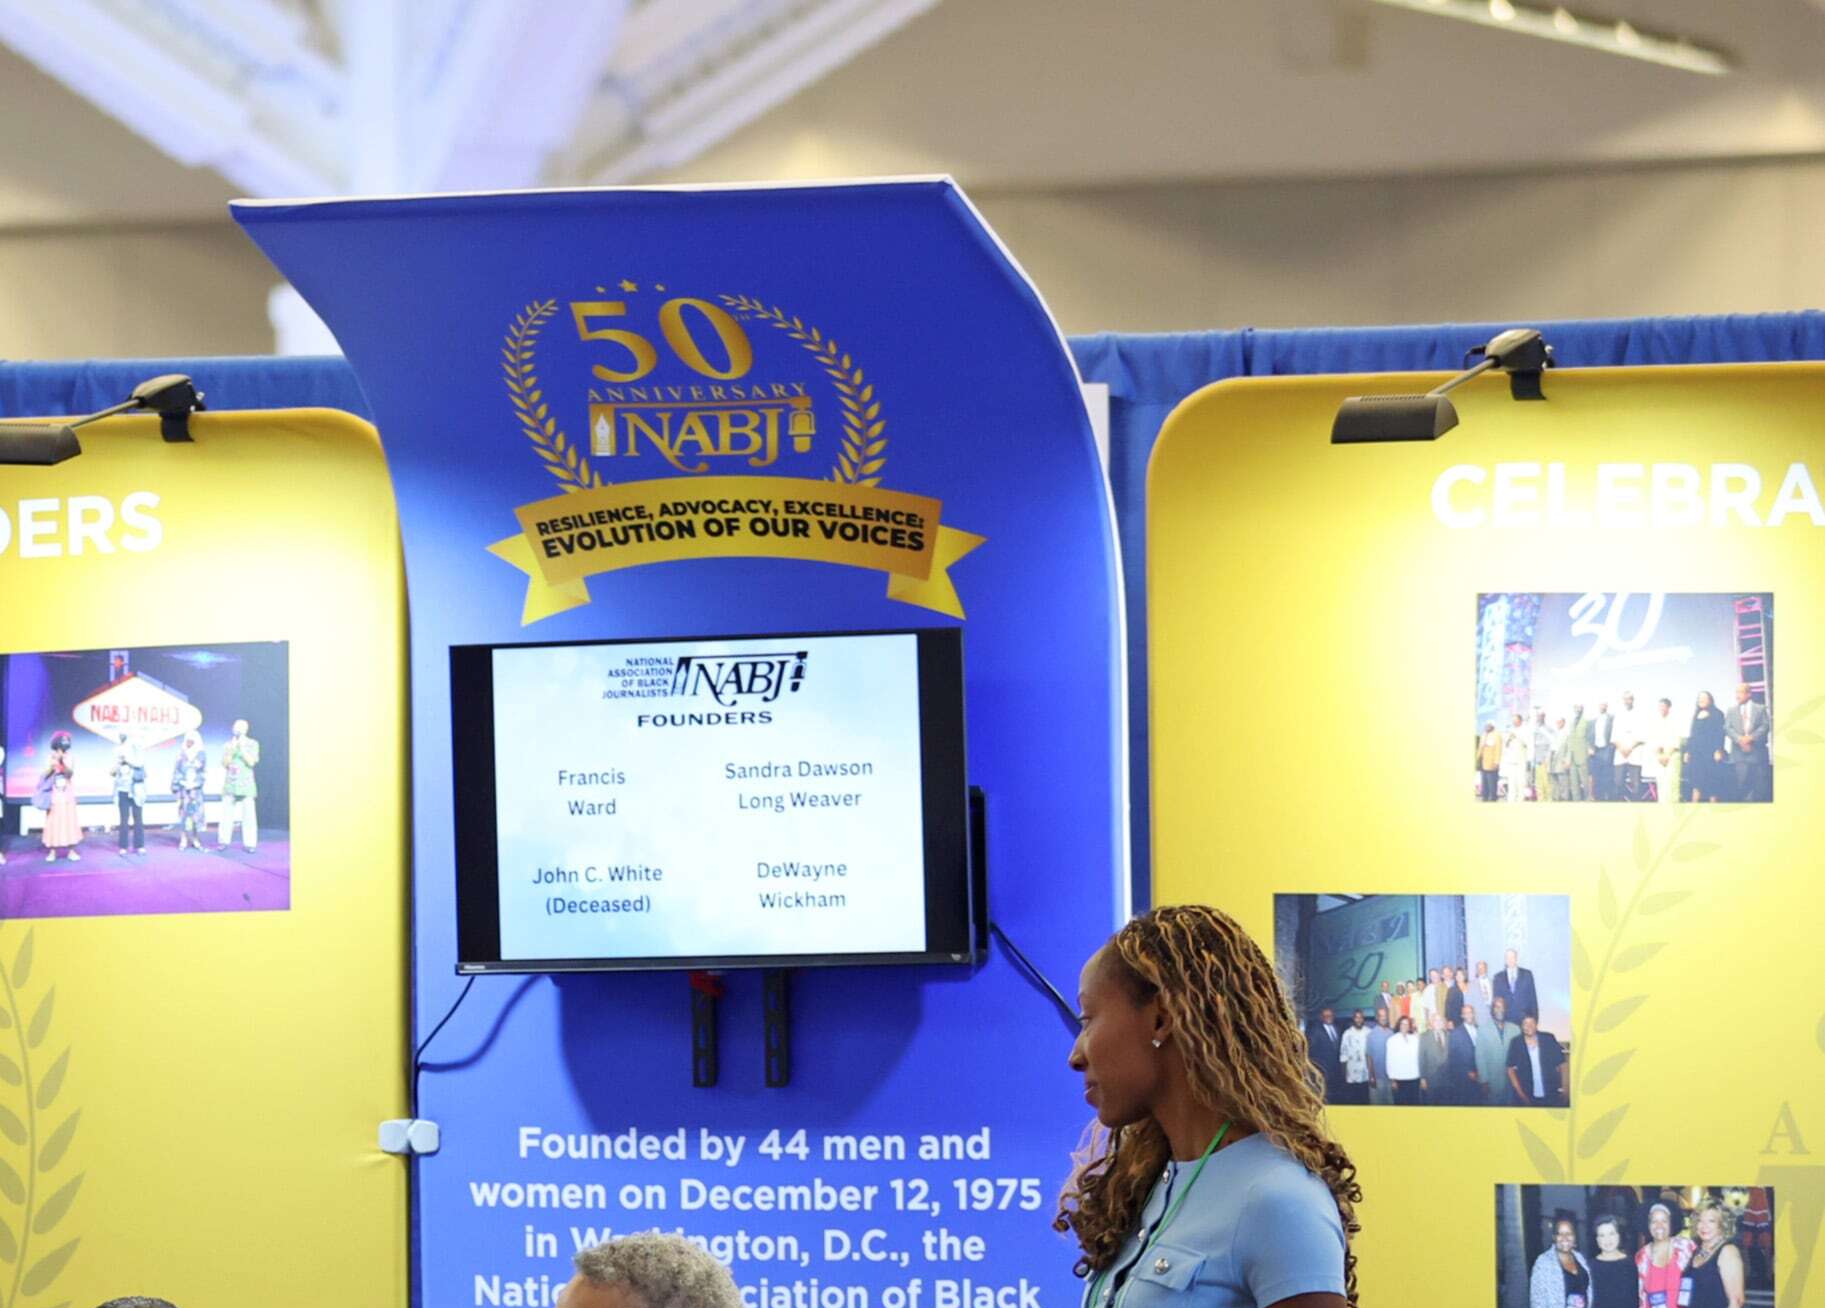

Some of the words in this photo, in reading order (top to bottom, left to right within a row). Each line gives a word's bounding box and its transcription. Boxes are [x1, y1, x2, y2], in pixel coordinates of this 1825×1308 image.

[570, 297, 753, 383] 50
[588, 383, 805, 401] ANNIVERSARY
[622, 408, 784, 472] NABJ
[536, 505, 654, 536] RESILIENCE,
[660, 499, 779, 519] ADVOCACY,
[784, 499, 924, 529] EXCELLENCE:
[542, 519, 696, 558] EVOLUTION
[704, 517, 740, 537] OF
[748, 517, 810, 539] OUR
[818, 520, 925, 552] VOICES
[626, 657, 674, 666] NATIONAL
[608, 668, 673, 677] ASSOCIATION
[622, 679, 634, 687] OF
[637, 678, 669, 687] BLACK
[690, 660, 790, 706] NABJ
[603, 689, 668, 699] JOURNALISTS
[637, 711, 773, 727] FOUNDERS
[557, 768, 626, 786] Francis
[725, 762, 792, 780] Sandra
[797, 760, 873, 778] Dawson
[568, 798, 617, 816] Ward
[739, 793, 785, 813] Long
[790, 791, 863, 807] Weaver
[532, 867, 578, 884] John
[584, 867, 603, 882] C.
[608, 865, 664, 882] White
[757, 862, 848, 881] DeWayne
[545, 895, 652, 915] (Deceased)
[759, 891, 846, 909] Wickham
[518, 1125, 686, 1161] Founded
[700, 1128, 746, 1167] by
[758, 1129, 810, 1161] 44
[823, 1135, 905, 1161] men
[918, 1127, 990, 1161] and
[468, 1181, 607, 1210] women
[618, 1183, 667, 1210] on
[680, 1177, 879, 1211] December
[889, 1178, 940, 1217] 12,
[953, 1178, 1042, 1211] 1975
[525, 1225, 558, 1258] in
[823, 1228, 910, 1268] D.C.,
[922, 1228, 986, 1262] the
